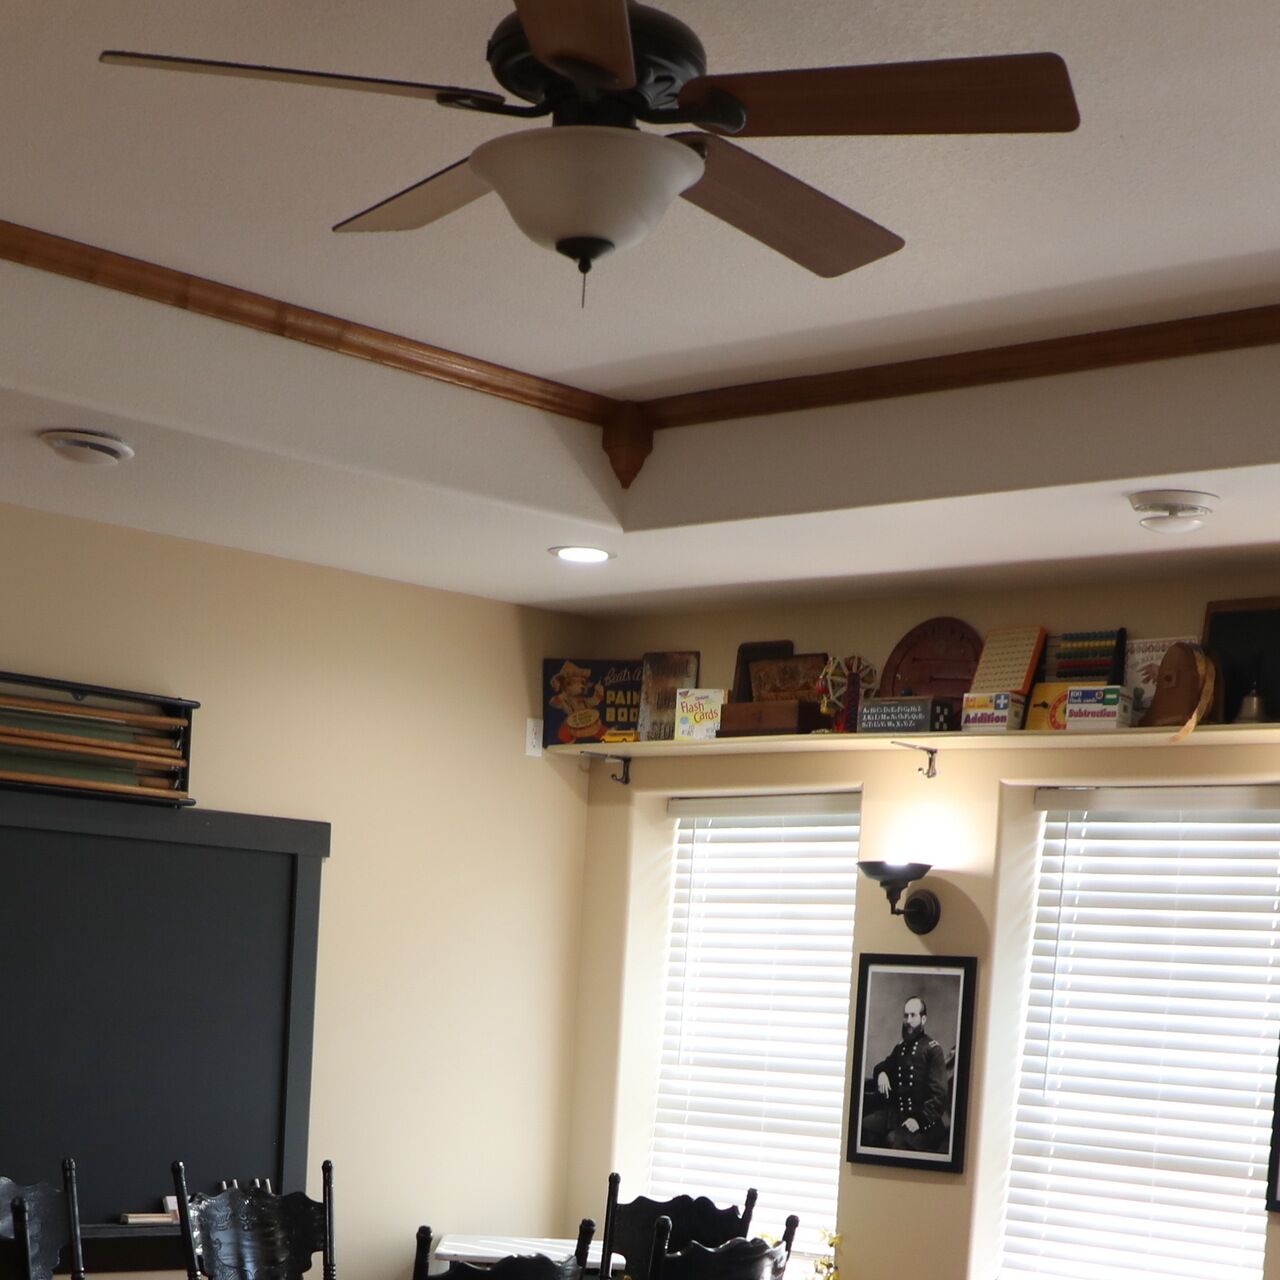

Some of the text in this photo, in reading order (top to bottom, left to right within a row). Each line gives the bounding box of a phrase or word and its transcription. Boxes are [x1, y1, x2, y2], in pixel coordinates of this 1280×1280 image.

[607, 690, 640, 704] PAIN
[681, 701, 704, 713] Flash
[1069, 708, 1116, 718] Subtraction
[606, 707, 638, 722] BOO
[694, 709, 718, 723] Cards
[964, 712, 1007, 724] Addition
